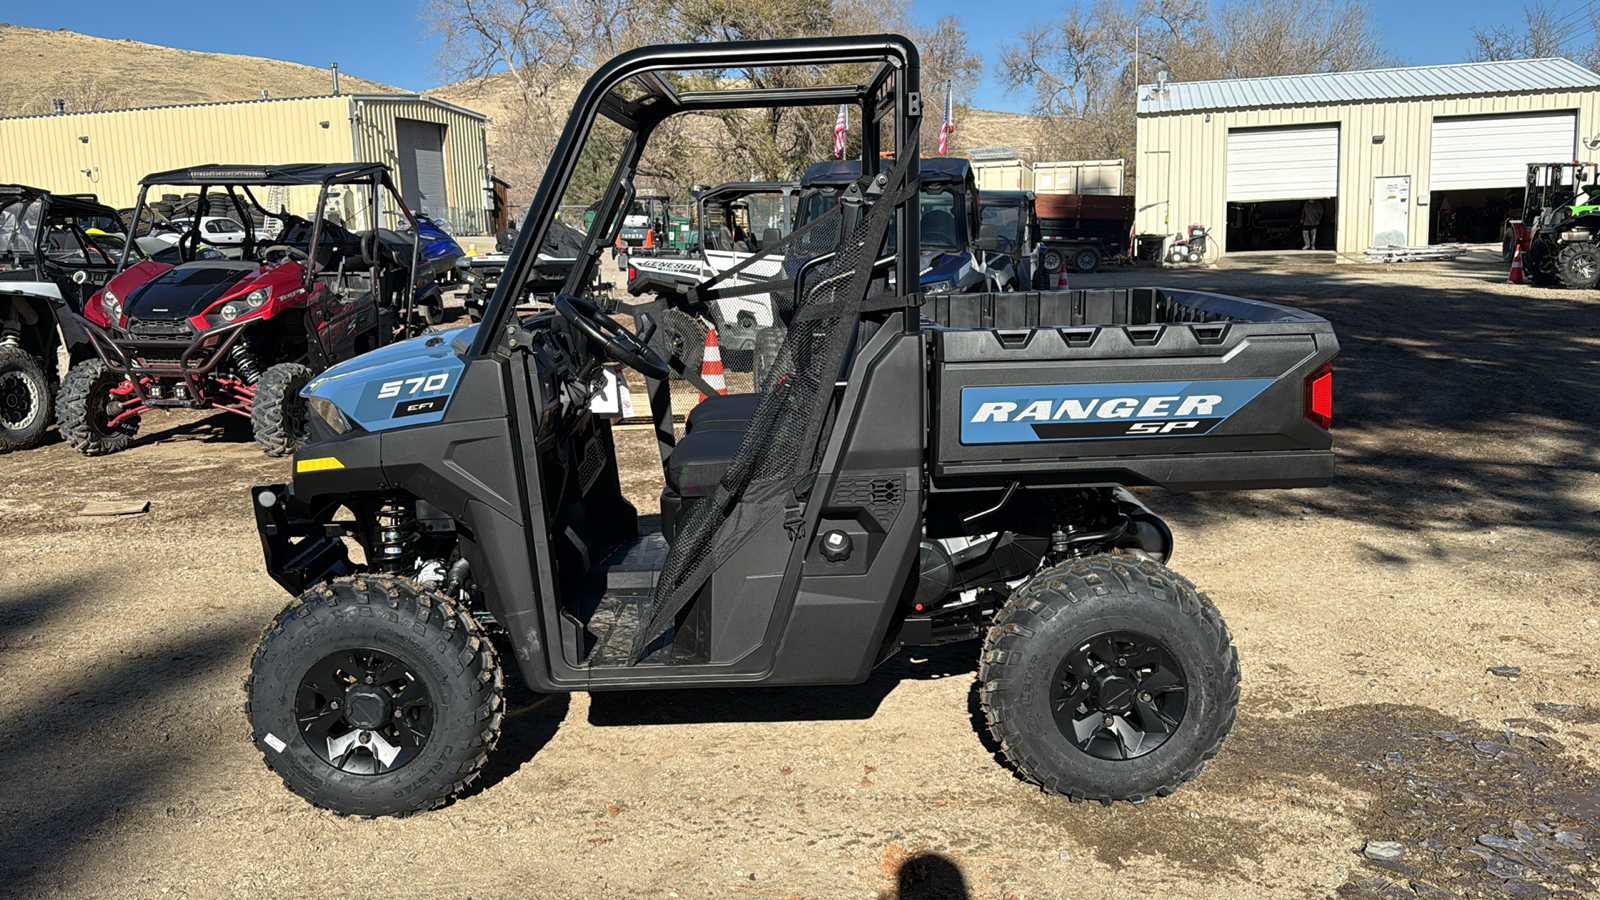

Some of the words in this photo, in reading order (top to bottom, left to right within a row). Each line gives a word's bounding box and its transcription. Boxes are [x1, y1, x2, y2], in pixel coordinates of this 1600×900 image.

[643, 260, 698, 272] GENERAL
[377, 373, 450, 399] 570
[407, 402, 434, 412] EFI
[970, 395, 1222, 423] RANGER
[1125, 421, 1199, 434] SP
[393, 744, 454, 799] CARLSTAR
